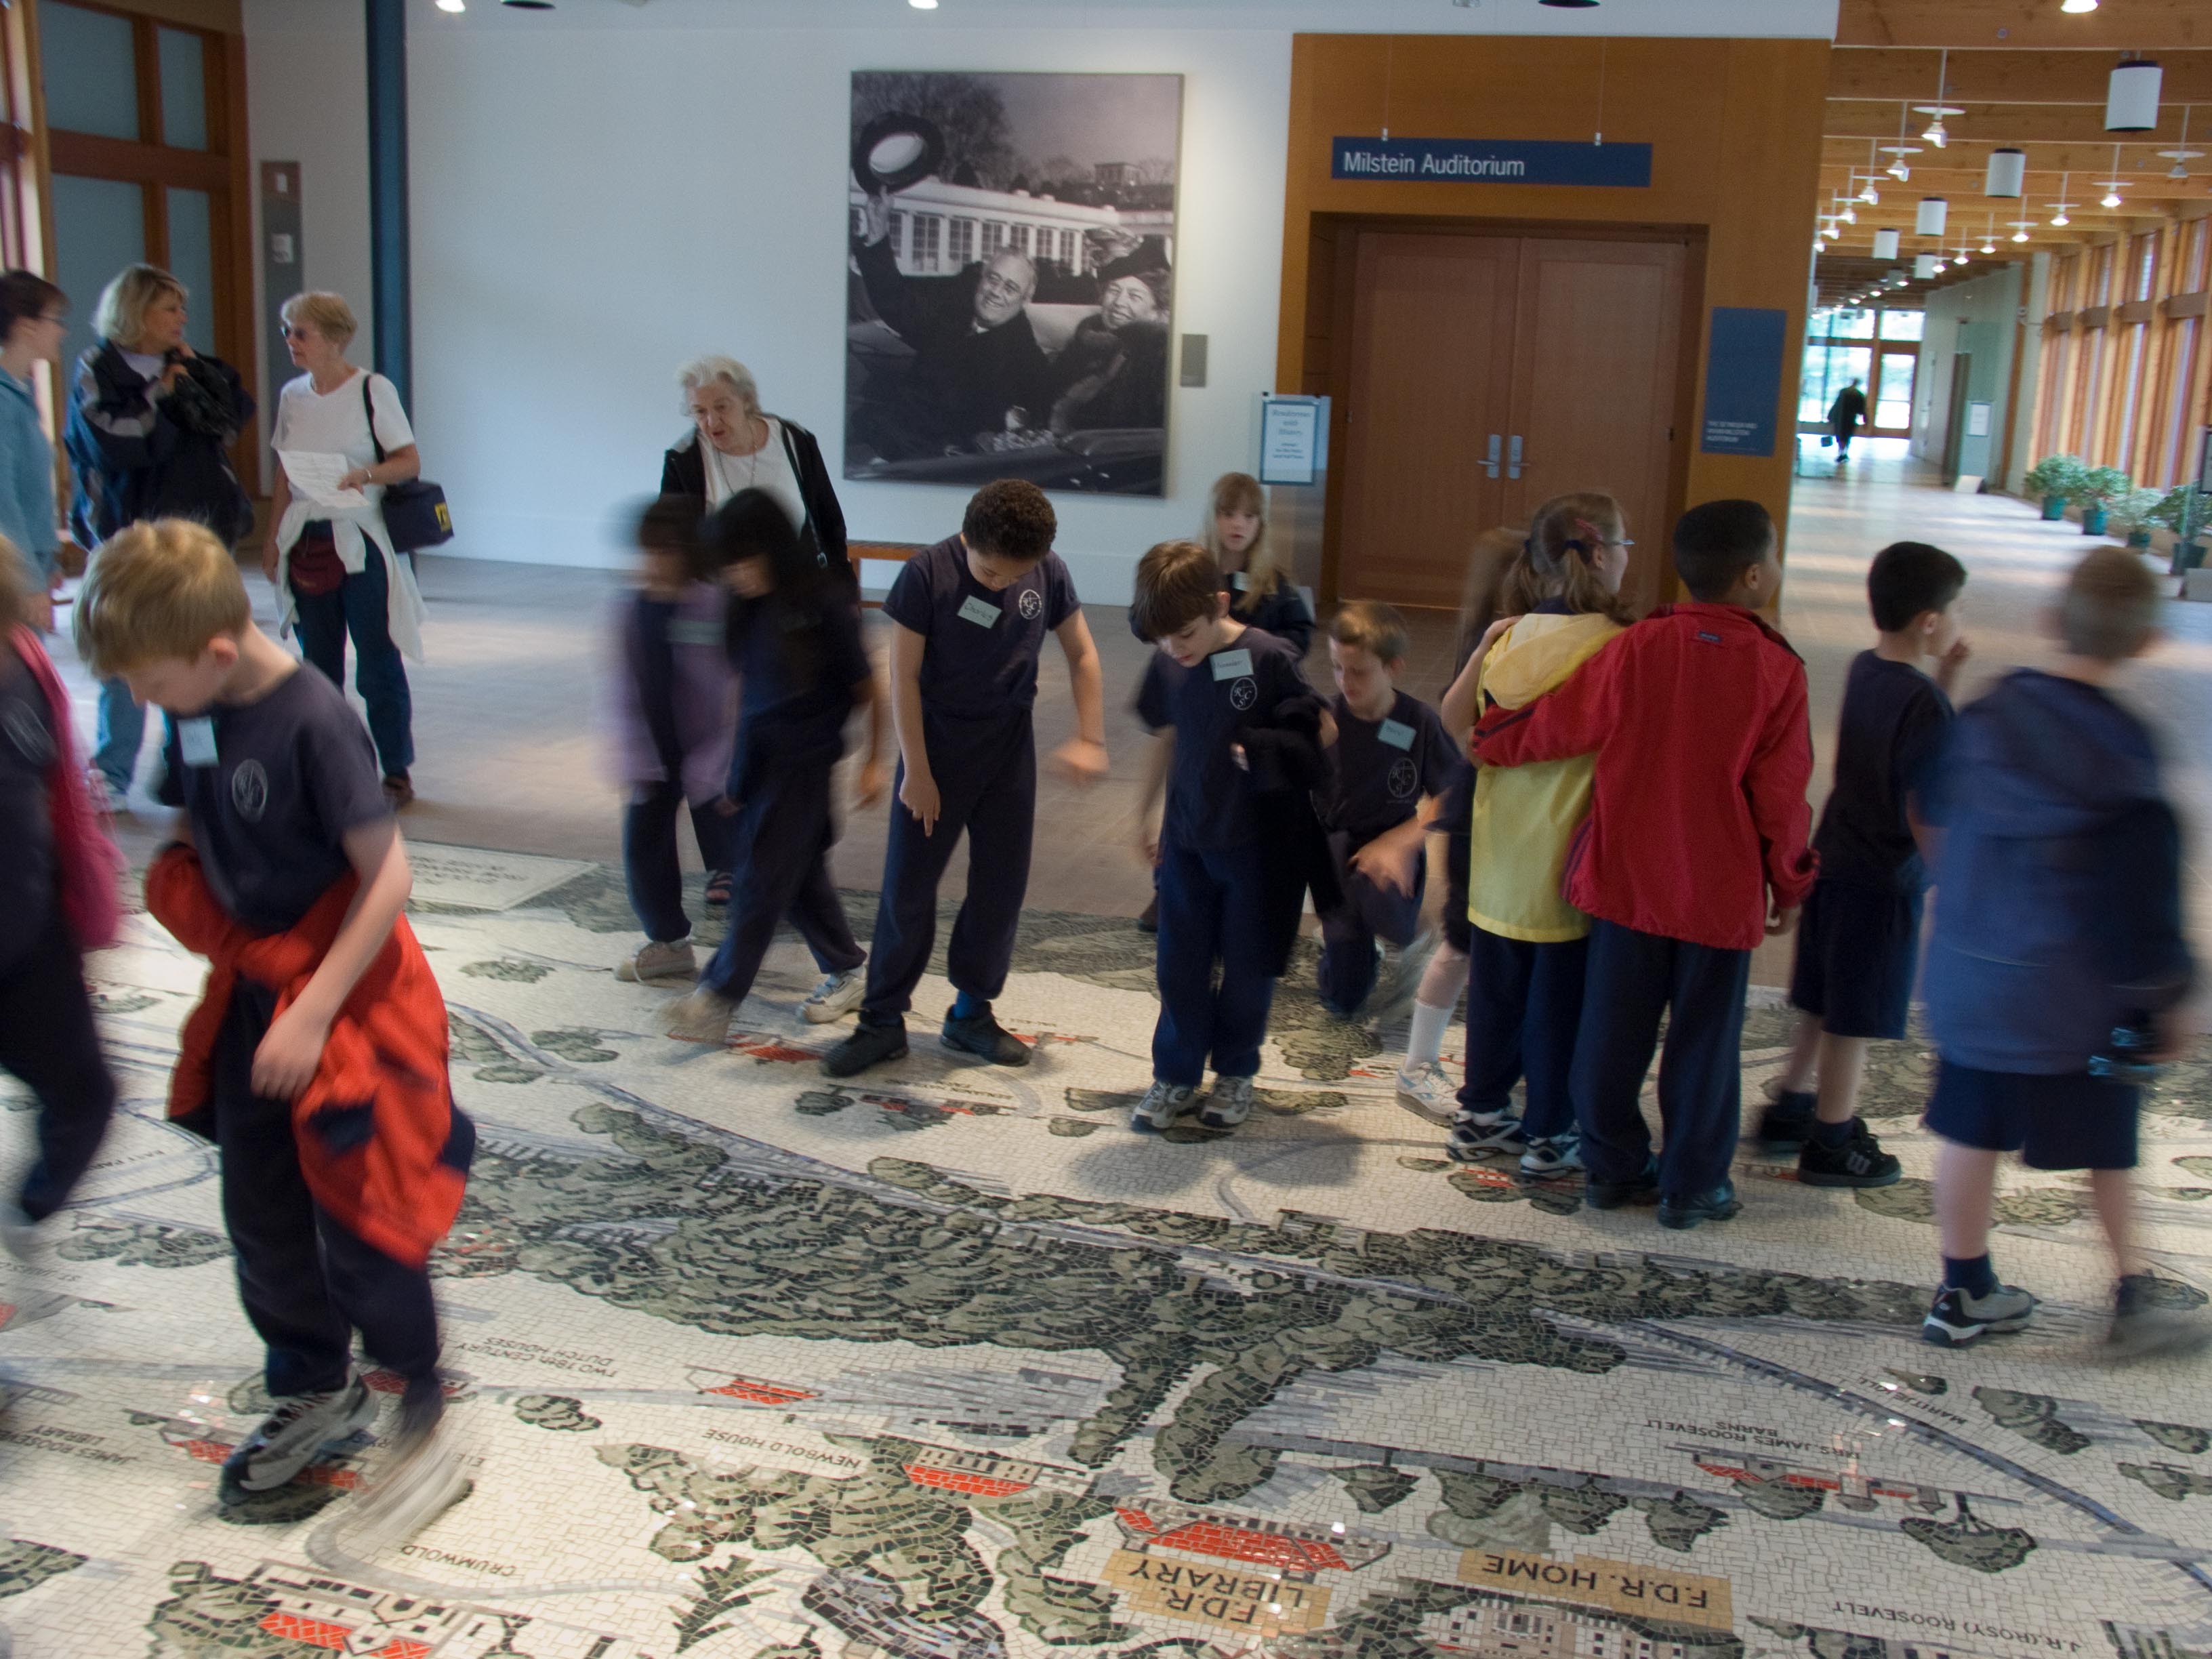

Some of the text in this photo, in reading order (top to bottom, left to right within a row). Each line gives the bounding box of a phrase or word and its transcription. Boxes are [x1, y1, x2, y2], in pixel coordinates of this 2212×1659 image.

[1344, 150, 1525, 176] Milstein Auditorium
[455, 1343, 535, 1361] CENTURY
[483, 1337, 614, 1367] DUTCH HOUSES
[579, 1364, 618, 1378] TWO
[26, 1425, 106, 1447] LIBRARY
[1644, 1420, 1746, 1443] ROOSEVELT
[1715, 1421, 1778, 1437] BARNS
[701, 1429, 861, 1469] NEWBOLD HOUSE
[1753, 1435, 1813, 1450] JAMES
[79, 1448, 140, 1466] JAMES
[401, 1544, 516, 1577] CRUMWOLD
[1128, 1559, 1303, 1608] LIBRARY
[1482, 1554, 1708, 1609] F.D.R. HOME
[1160, 1586, 1257, 1624] F.D.R.
[1832, 1601, 1955, 1631] ROOSEVELT
